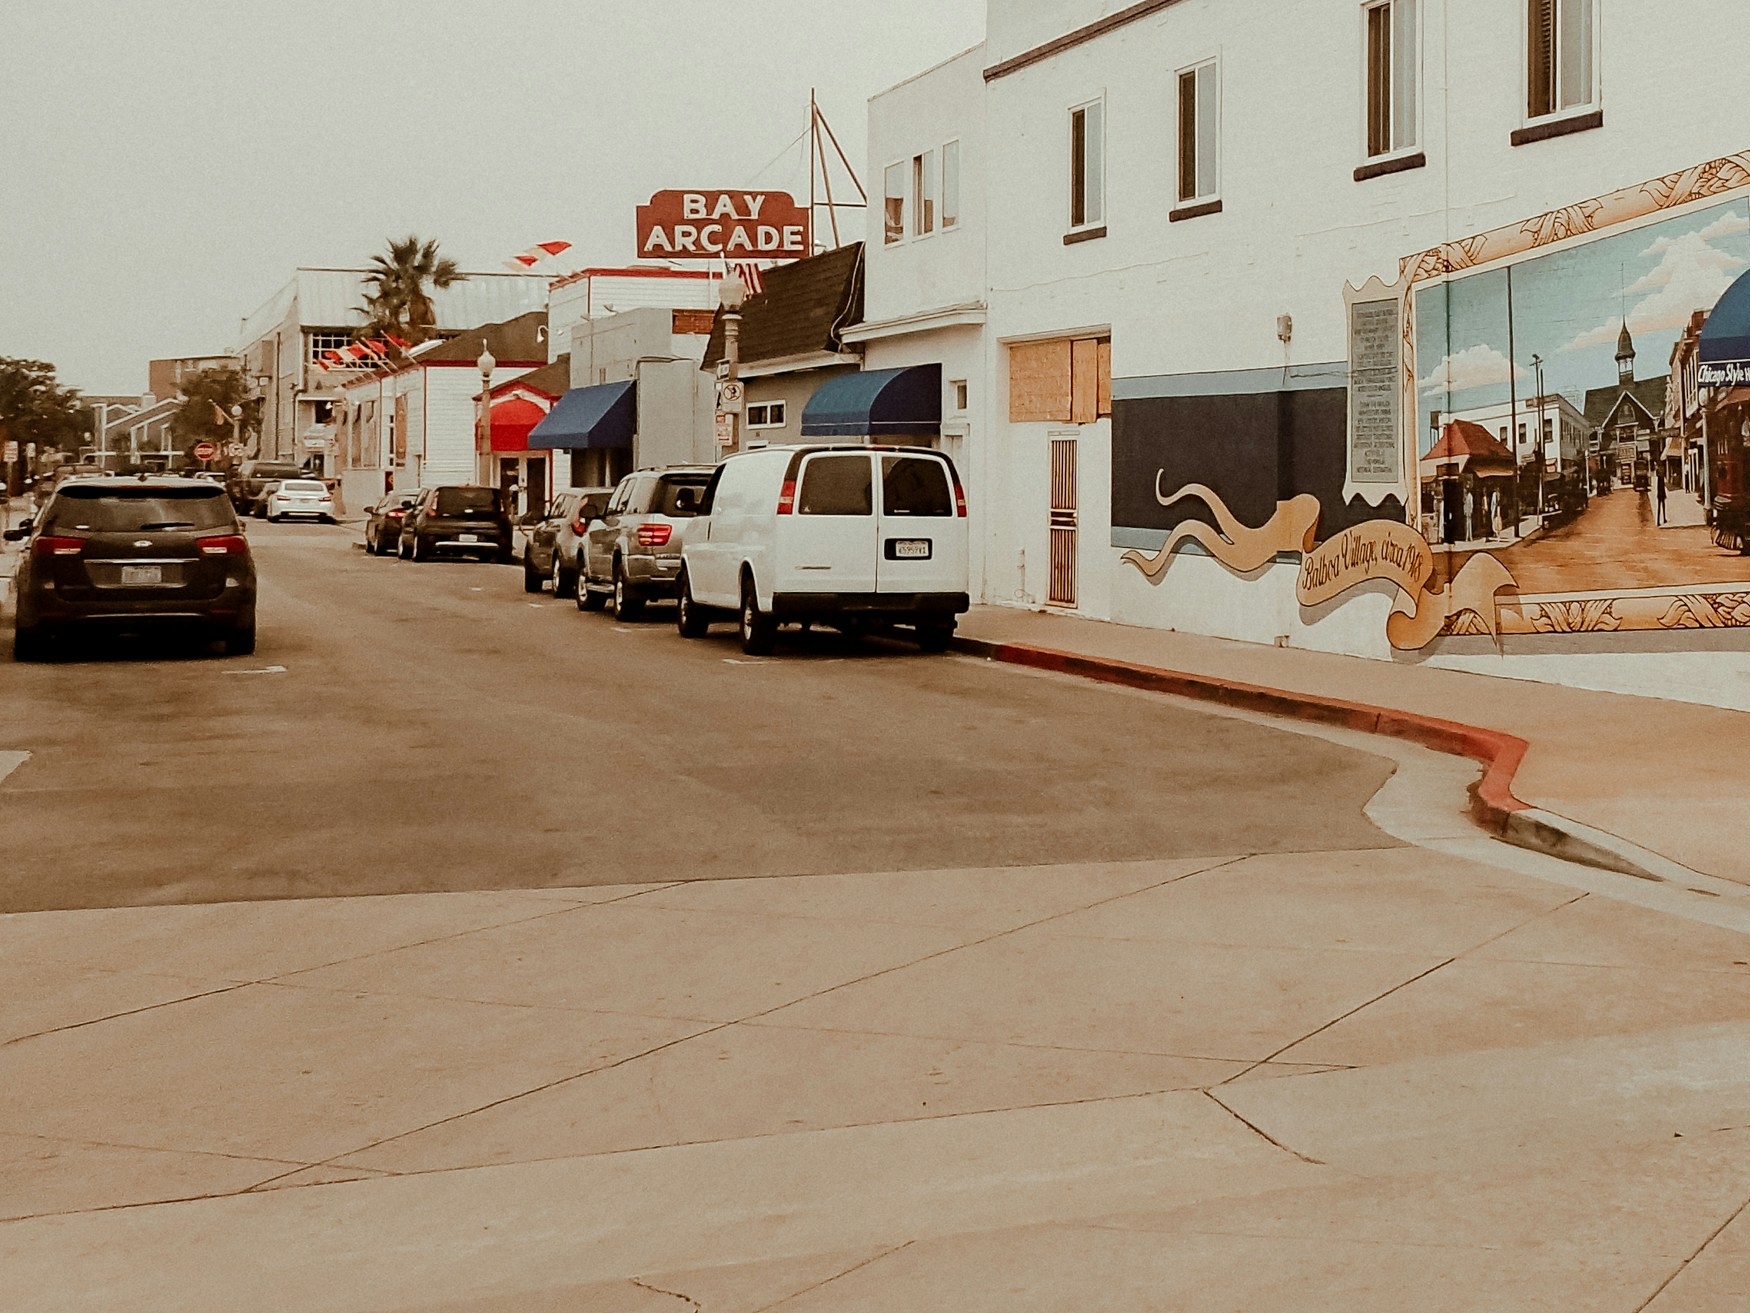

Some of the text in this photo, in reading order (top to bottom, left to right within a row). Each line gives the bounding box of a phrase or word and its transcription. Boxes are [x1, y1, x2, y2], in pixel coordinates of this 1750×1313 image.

[683, 193, 766, 220] BAY
[643, 224, 804, 252] ARCADE
[1698, 363, 1725, 387] Chicago
[1301, 554, 1340, 591] Balboa
[1381, 531, 1404, 568] circa
